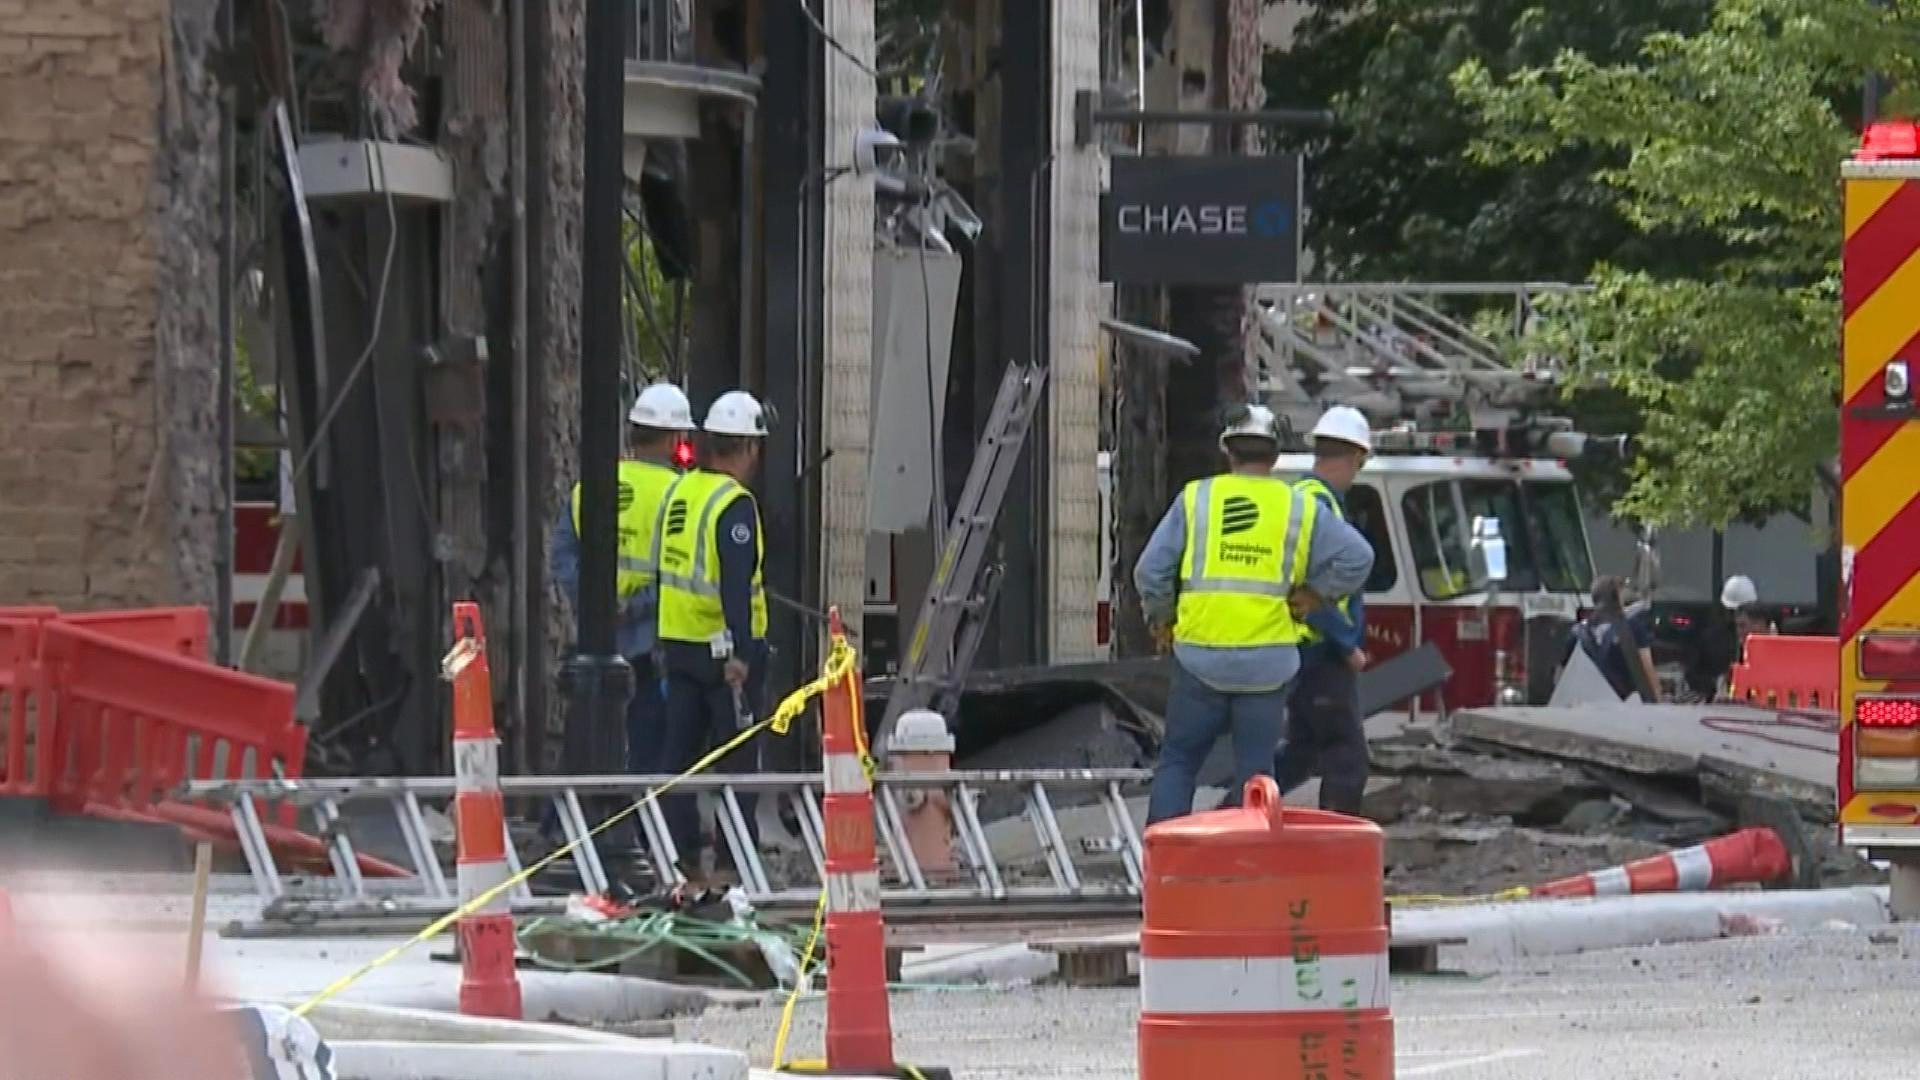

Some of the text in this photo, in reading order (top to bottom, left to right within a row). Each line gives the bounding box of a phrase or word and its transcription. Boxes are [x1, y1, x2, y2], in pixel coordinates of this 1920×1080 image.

[1118, 204, 1248, 234] CHASE
[1219, 540, 1273, 556] Dominion
[1219, 551, 1260, 566] Energy
